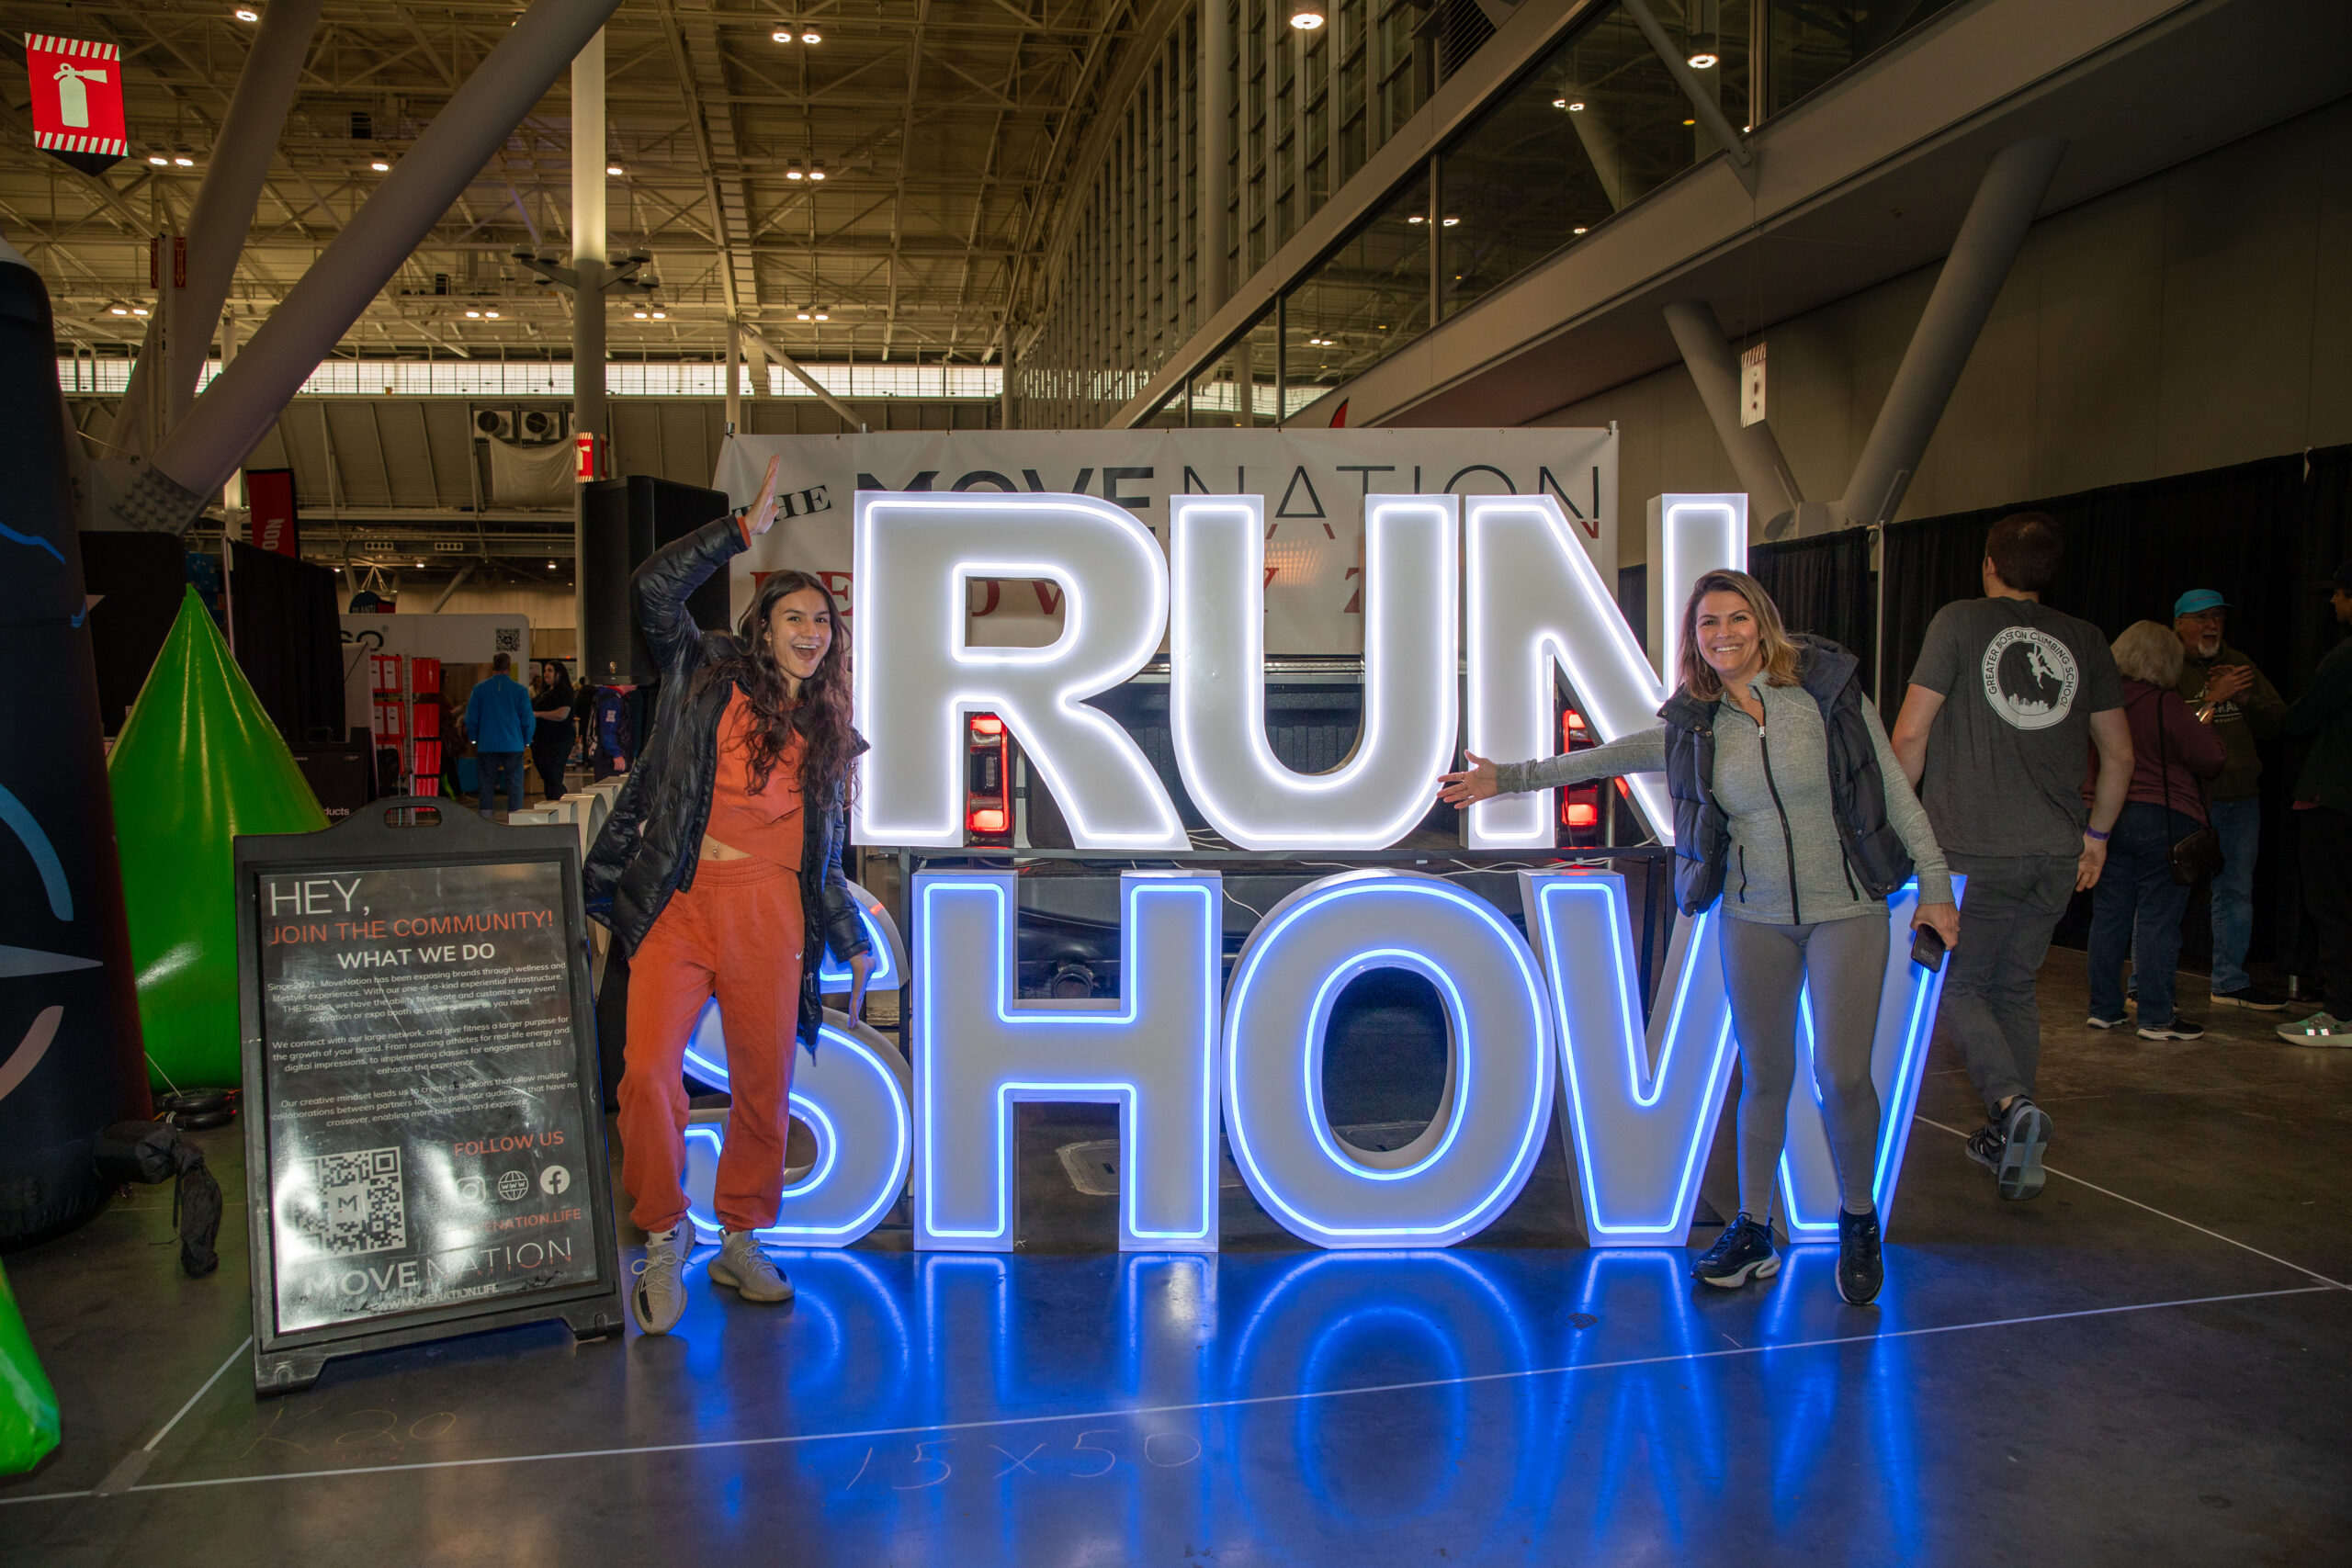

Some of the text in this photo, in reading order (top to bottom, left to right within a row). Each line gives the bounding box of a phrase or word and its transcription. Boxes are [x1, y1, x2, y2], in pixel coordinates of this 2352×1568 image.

[853, 491, 1749, 855] RUN
[1985, 630, 2075, 708] GREATER BOSTON CLIMBING SCHOOL
[270, 878, 369, 916] HEY,
[270, 910, 553, 944] JOIN THE COMMUNITY!
[337, 943, 495, 969] WHAT WE DO
[273, 994, 306, 1002] lifestyle
[402, 982, 458, 992] one-of-a-kind
[460, 978, 506, 988] experiential
[508, 975, 562, 984] infrastructure,
[321, 977, 371, 987] MoveNation
[413, 972, 450, 981] exposing
[482, 966, 514, 975] through
[427, 993, 457, 1001] elevate
[476, 988, 515, 997] customize
[310, 1013, 351, 1022] activation
[493, 1000, 508, 1009] you
[289, 1050, 321, 1061] growth
[334, 1048, 353, 1056] your
[356, 1044, 382, 1053] brand.
[409, 1039, 444, 1048] sourcing
[446, 1036, 479, 1044] athletes
[493, 1032, 524, 1040] real-life
[290, 1038, 325, 1047] connect
[426, 1027, 442, 1035] and
[445, 1026, 461, 1035] give
[525, 1019, 556, 1028] purpose
[284, 1062, 312, 1072] digital
[314, 1058, 368, 1069] impressions,
[380, 1051, 437, 1063] implementing
[484, 1041, 534, 1053] engagement
[536, 1039, 551, 1047] and
[377, 1066, 413, 1074] enhance
[300, 1097, 335, 1106] creative
[336, 1091, 371, 1101] mindset
[373, 1089, 397, 1098] leads
[421, 1084, 447, 1093] create
[449, 1080, 493, 1090] ativations
[537, 1072, 569, 1080] multiple
[272, 1109, 334, 1121] collaborations
[336, 1104, 374, 1113] between
[377, 1100, 413, 1111] partners
[449, 1091, 483, 1103] pollinate
[326, 1117, 371, 1126] crossover,
[373, 1111, 410, 1121] enabling
[435, 1105, 470, 1114] business
[472, 1101, 489, 1110] and
[454, 1131, 564, 1157] FOLLOW US
[844, 1437, 958, 1491] 15
[1068, 1428, 1203, 1479] 50
